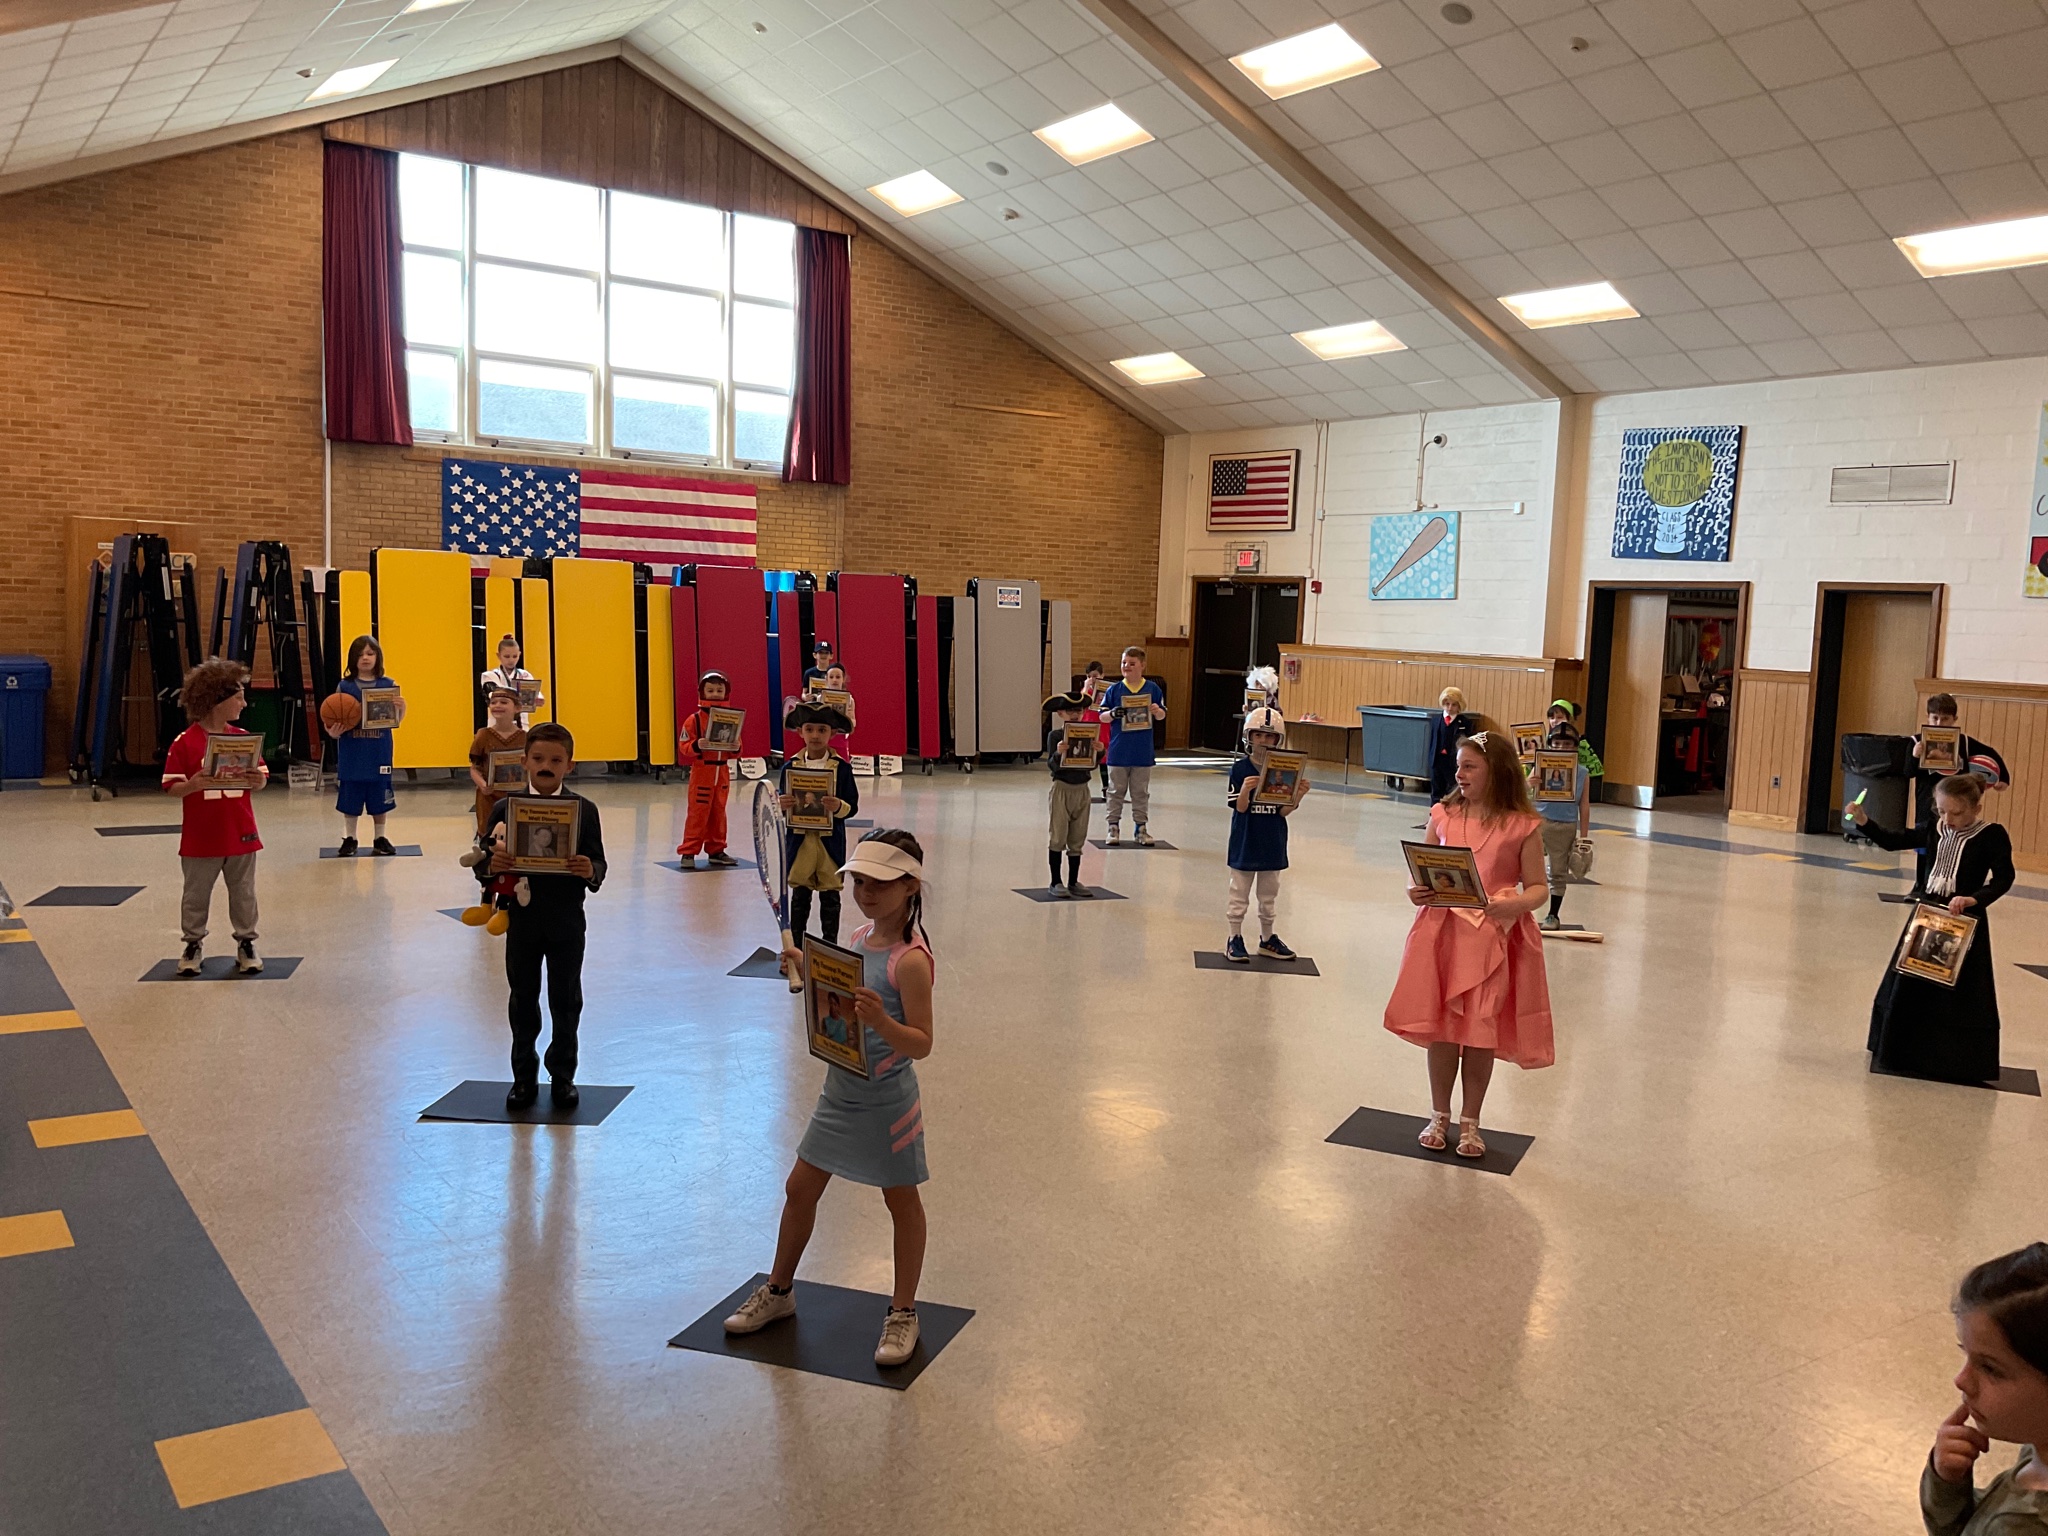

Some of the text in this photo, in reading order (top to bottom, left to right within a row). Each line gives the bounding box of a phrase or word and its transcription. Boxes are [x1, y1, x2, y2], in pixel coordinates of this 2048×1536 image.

[1666, 443, 1710, 470] IMPORTANT
[1659, 457, 1698, 473] THING IS
[1655, 474, 1700, 490] NOT TO STOP
[1662, 511, 1681, 522] CLASS
[1667, 523, 1676, 533] OF
[1240, 552, 1252, 564] EXIT
[1251, 805, 1277, 814] COLTS
